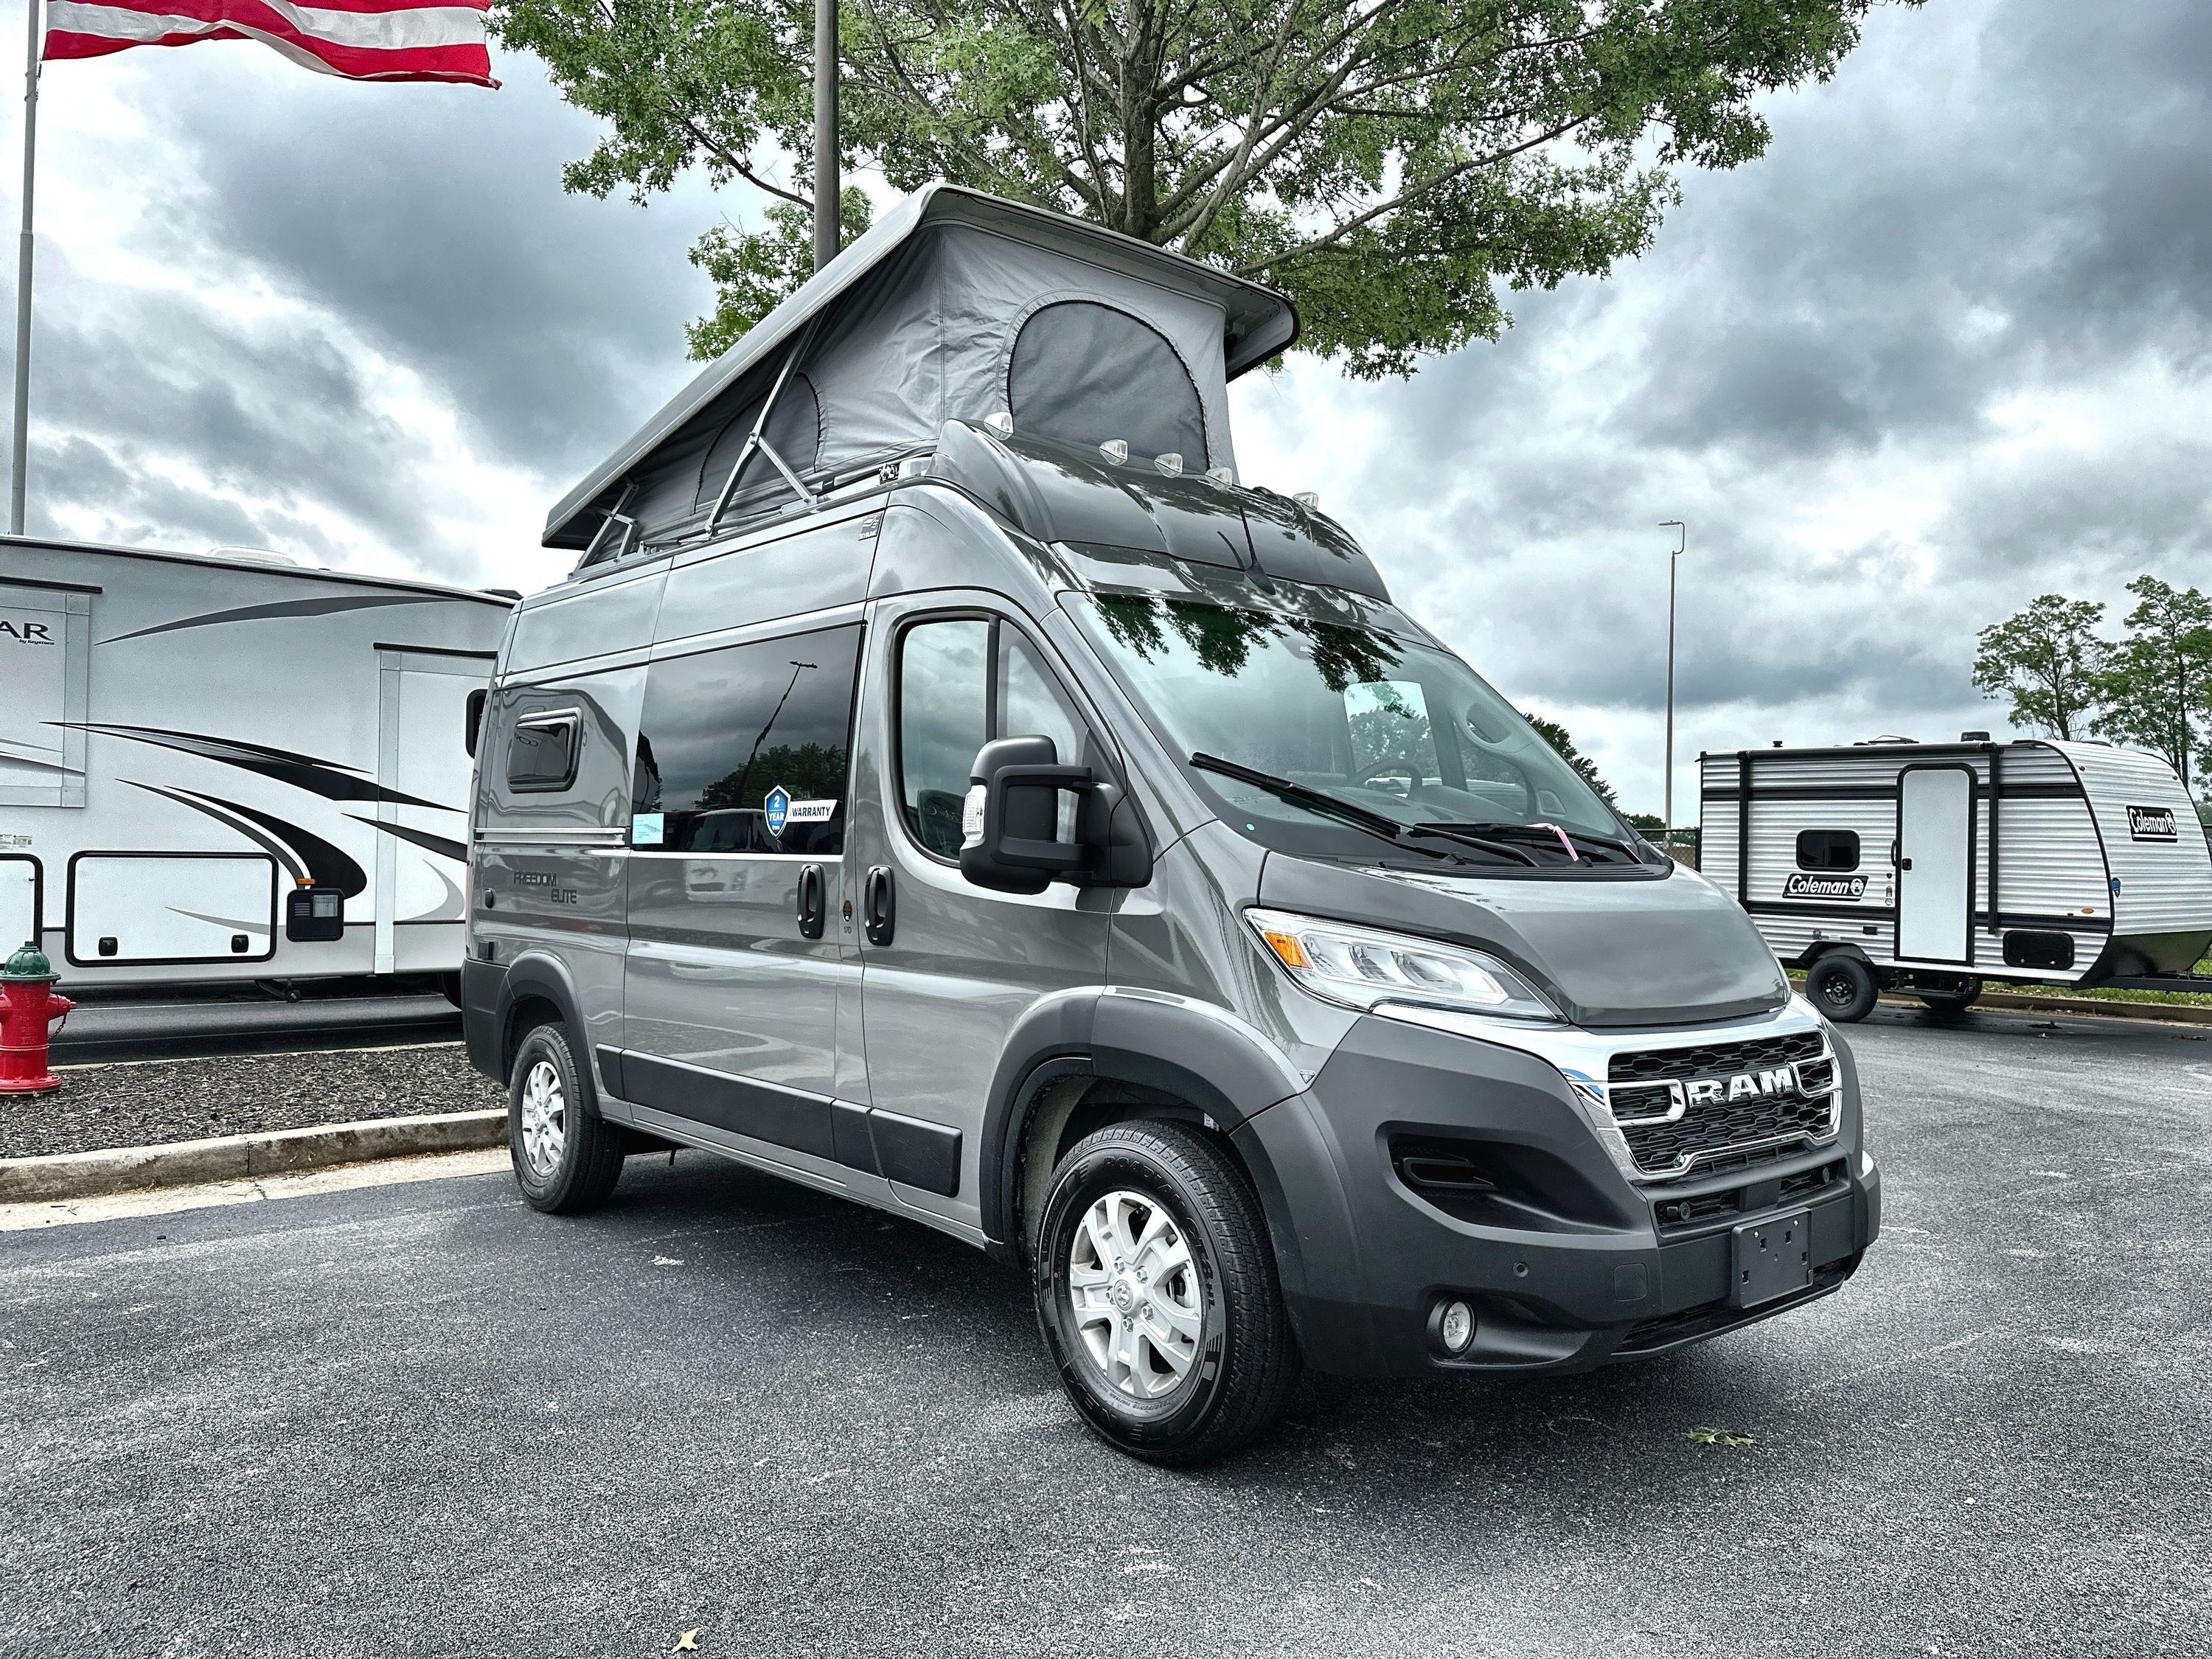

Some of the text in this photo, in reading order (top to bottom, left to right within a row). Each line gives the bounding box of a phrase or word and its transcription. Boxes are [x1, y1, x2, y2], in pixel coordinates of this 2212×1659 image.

[773, 796, 780, 808] 2
[769, 812, 785, 821] YEAR
[792, 807, 830, 817] WARRANTY
[2129, 807, 2168, 833] Coleman
[514, 871, 557, 886] FREEDOM
[1789, 874, 1850, 894] Coleman
[551, 888, 577, 904] ELITE
[1685, 1068, 1795, 1107] RAM
